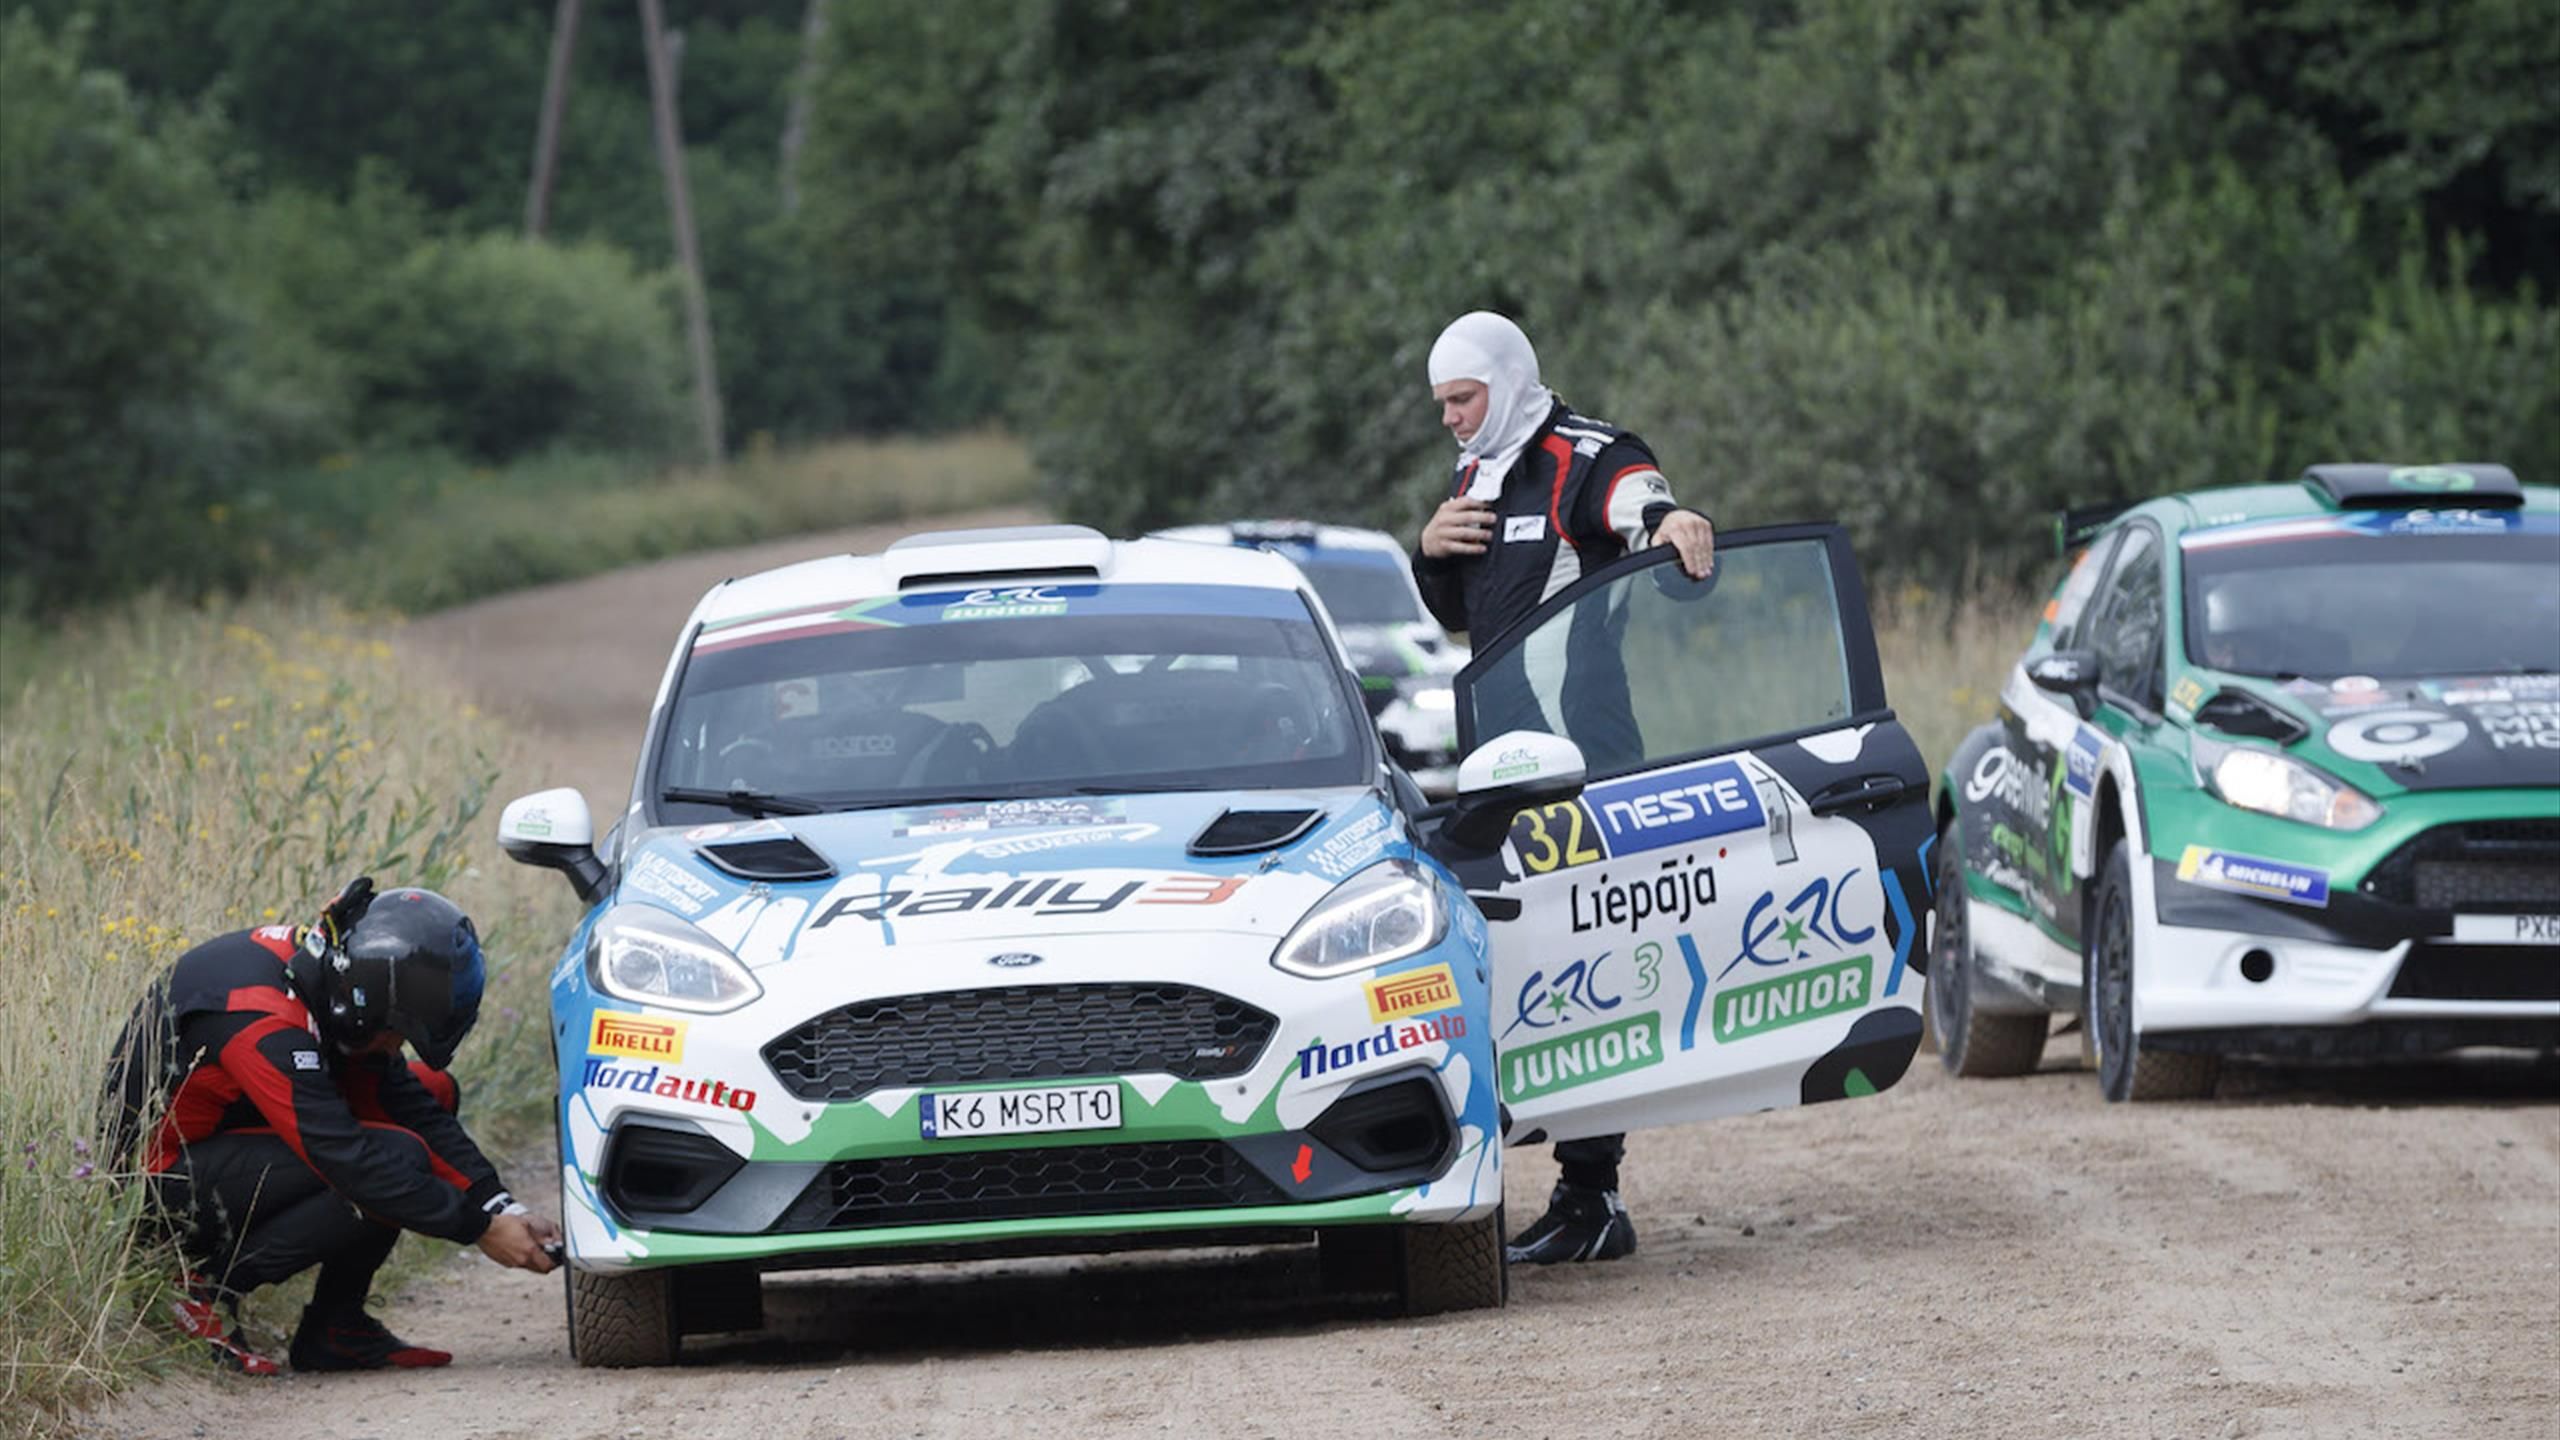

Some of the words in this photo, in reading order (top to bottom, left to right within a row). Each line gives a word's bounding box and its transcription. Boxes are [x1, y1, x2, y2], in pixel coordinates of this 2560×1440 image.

[946, 586, 1067, 608] ERC
[950, 604, 1058, 619] JUNIOR
[1511, 800, 1600, 872] 32
[1603, 778, 1748, 835] NESTE
[1571, 854, 1717, 933] Liepāja
[2227, 863, 2311, 892] MICHELIN
[1716, 867, 1875, 982] ERC
[1375, 972, 1452, 1013] PIRELLI
[1500, 951, 1621, 1040] ERC
[1633, 940, 1664, 1001] 3
[1723, 972, 1862, 1036] JUNIOR
[596, 1018, 676, 1055] PIRELLI
[1512, 1027, 1651, 1096] JUNIOR
[942, 1096, 986, 1131] K6
